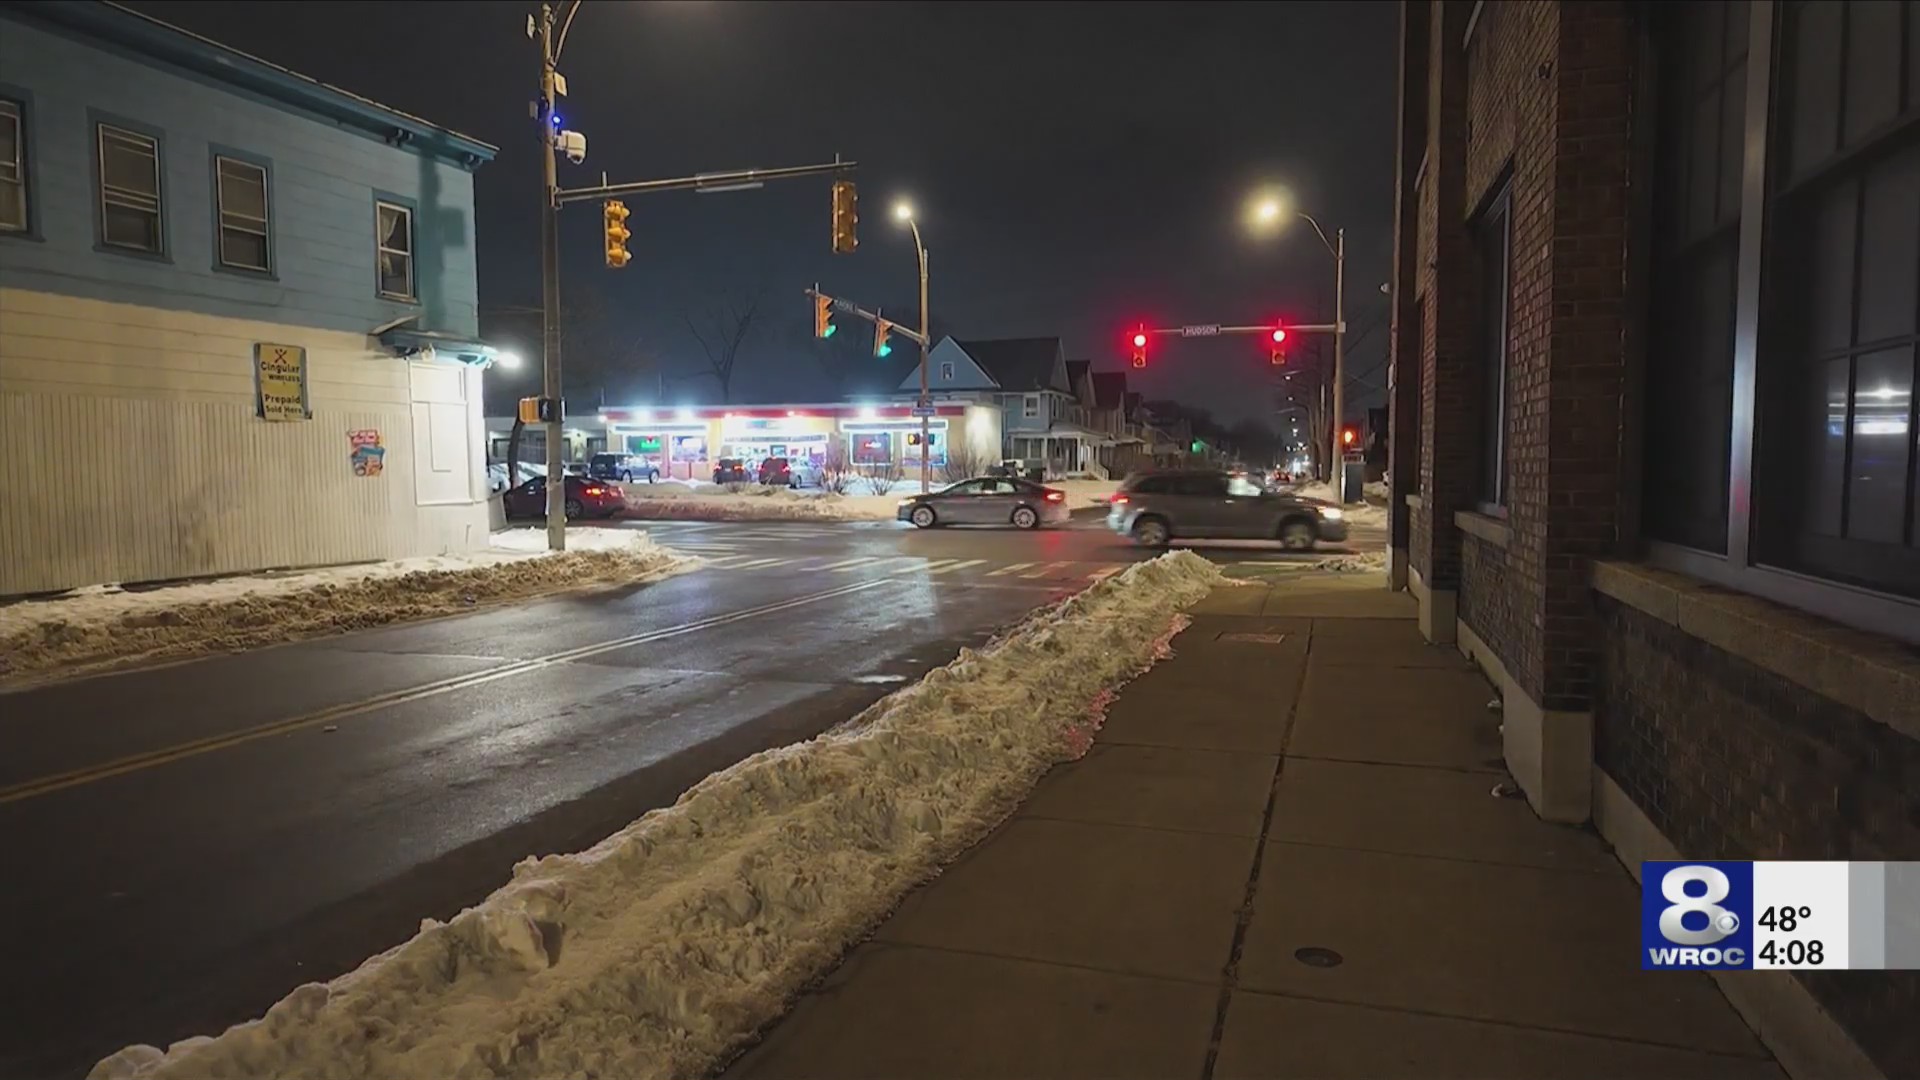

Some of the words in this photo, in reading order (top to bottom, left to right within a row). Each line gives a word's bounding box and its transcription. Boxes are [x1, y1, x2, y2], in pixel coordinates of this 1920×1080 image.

[1186, 326, 1216, 336] HUDSON
[261, 361, 300, 374] Cingular
[265, 393, 300, 405] Prepaid
[266, 405, 282, 414] Sold
[283, 405, 302, 414] Here
